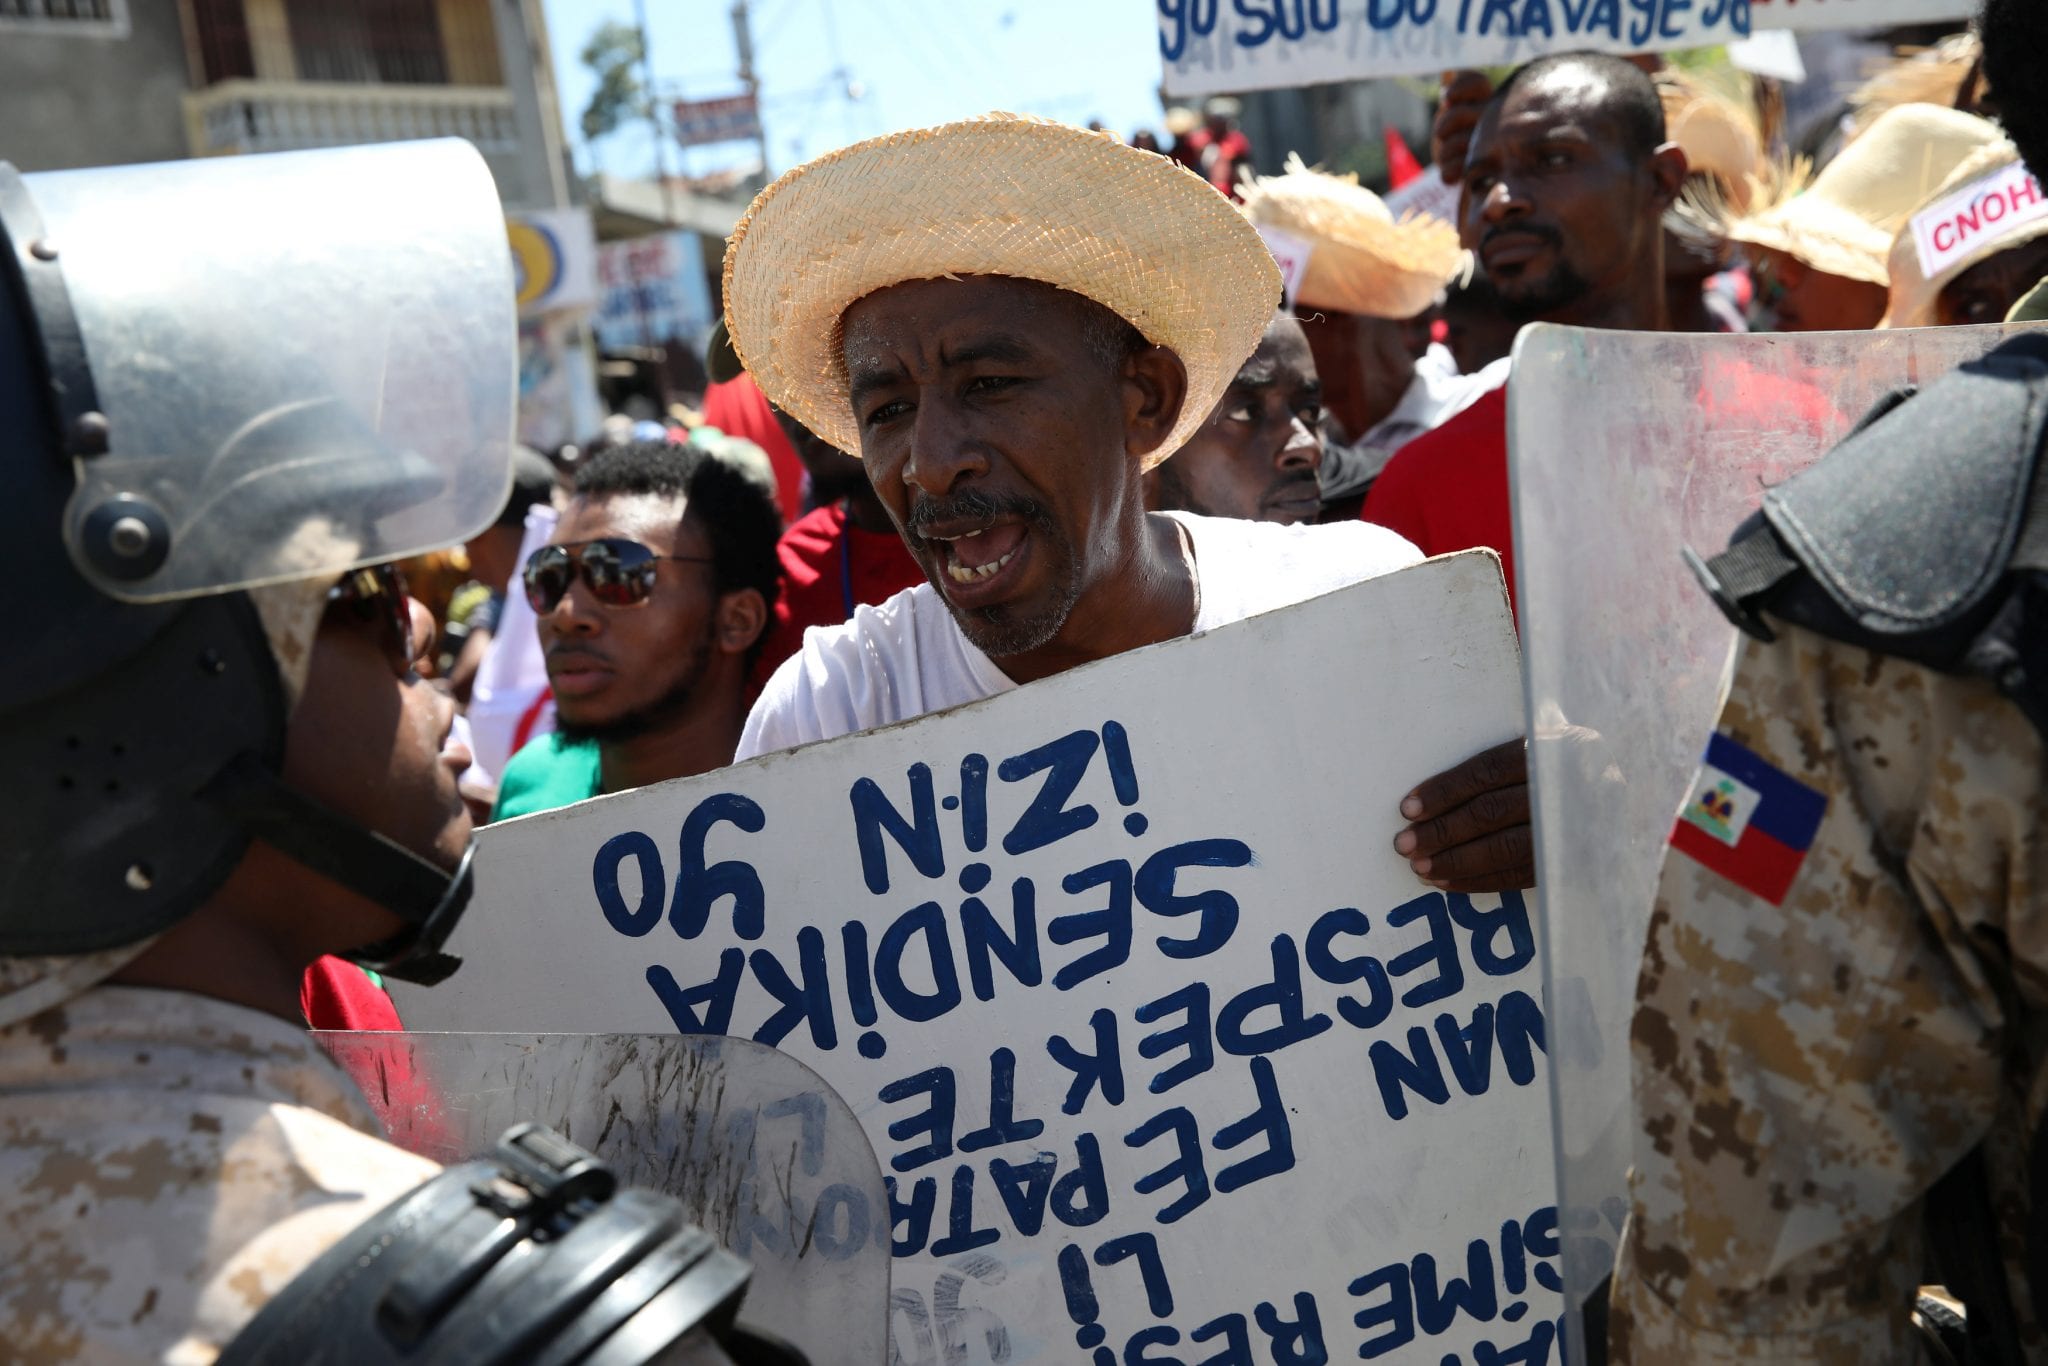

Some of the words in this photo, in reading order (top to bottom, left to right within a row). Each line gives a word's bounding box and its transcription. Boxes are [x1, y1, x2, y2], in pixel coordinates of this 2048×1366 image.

[1933, 177, 2048, 253] CNOH
[645, 838, 1252, 1060] SENDIKA
[877, 889, 1536, 1173] RESPEKTE
[1123, 1057, 1295, 1224] FE
[1348, 1196, 1628, 1359] SIME
